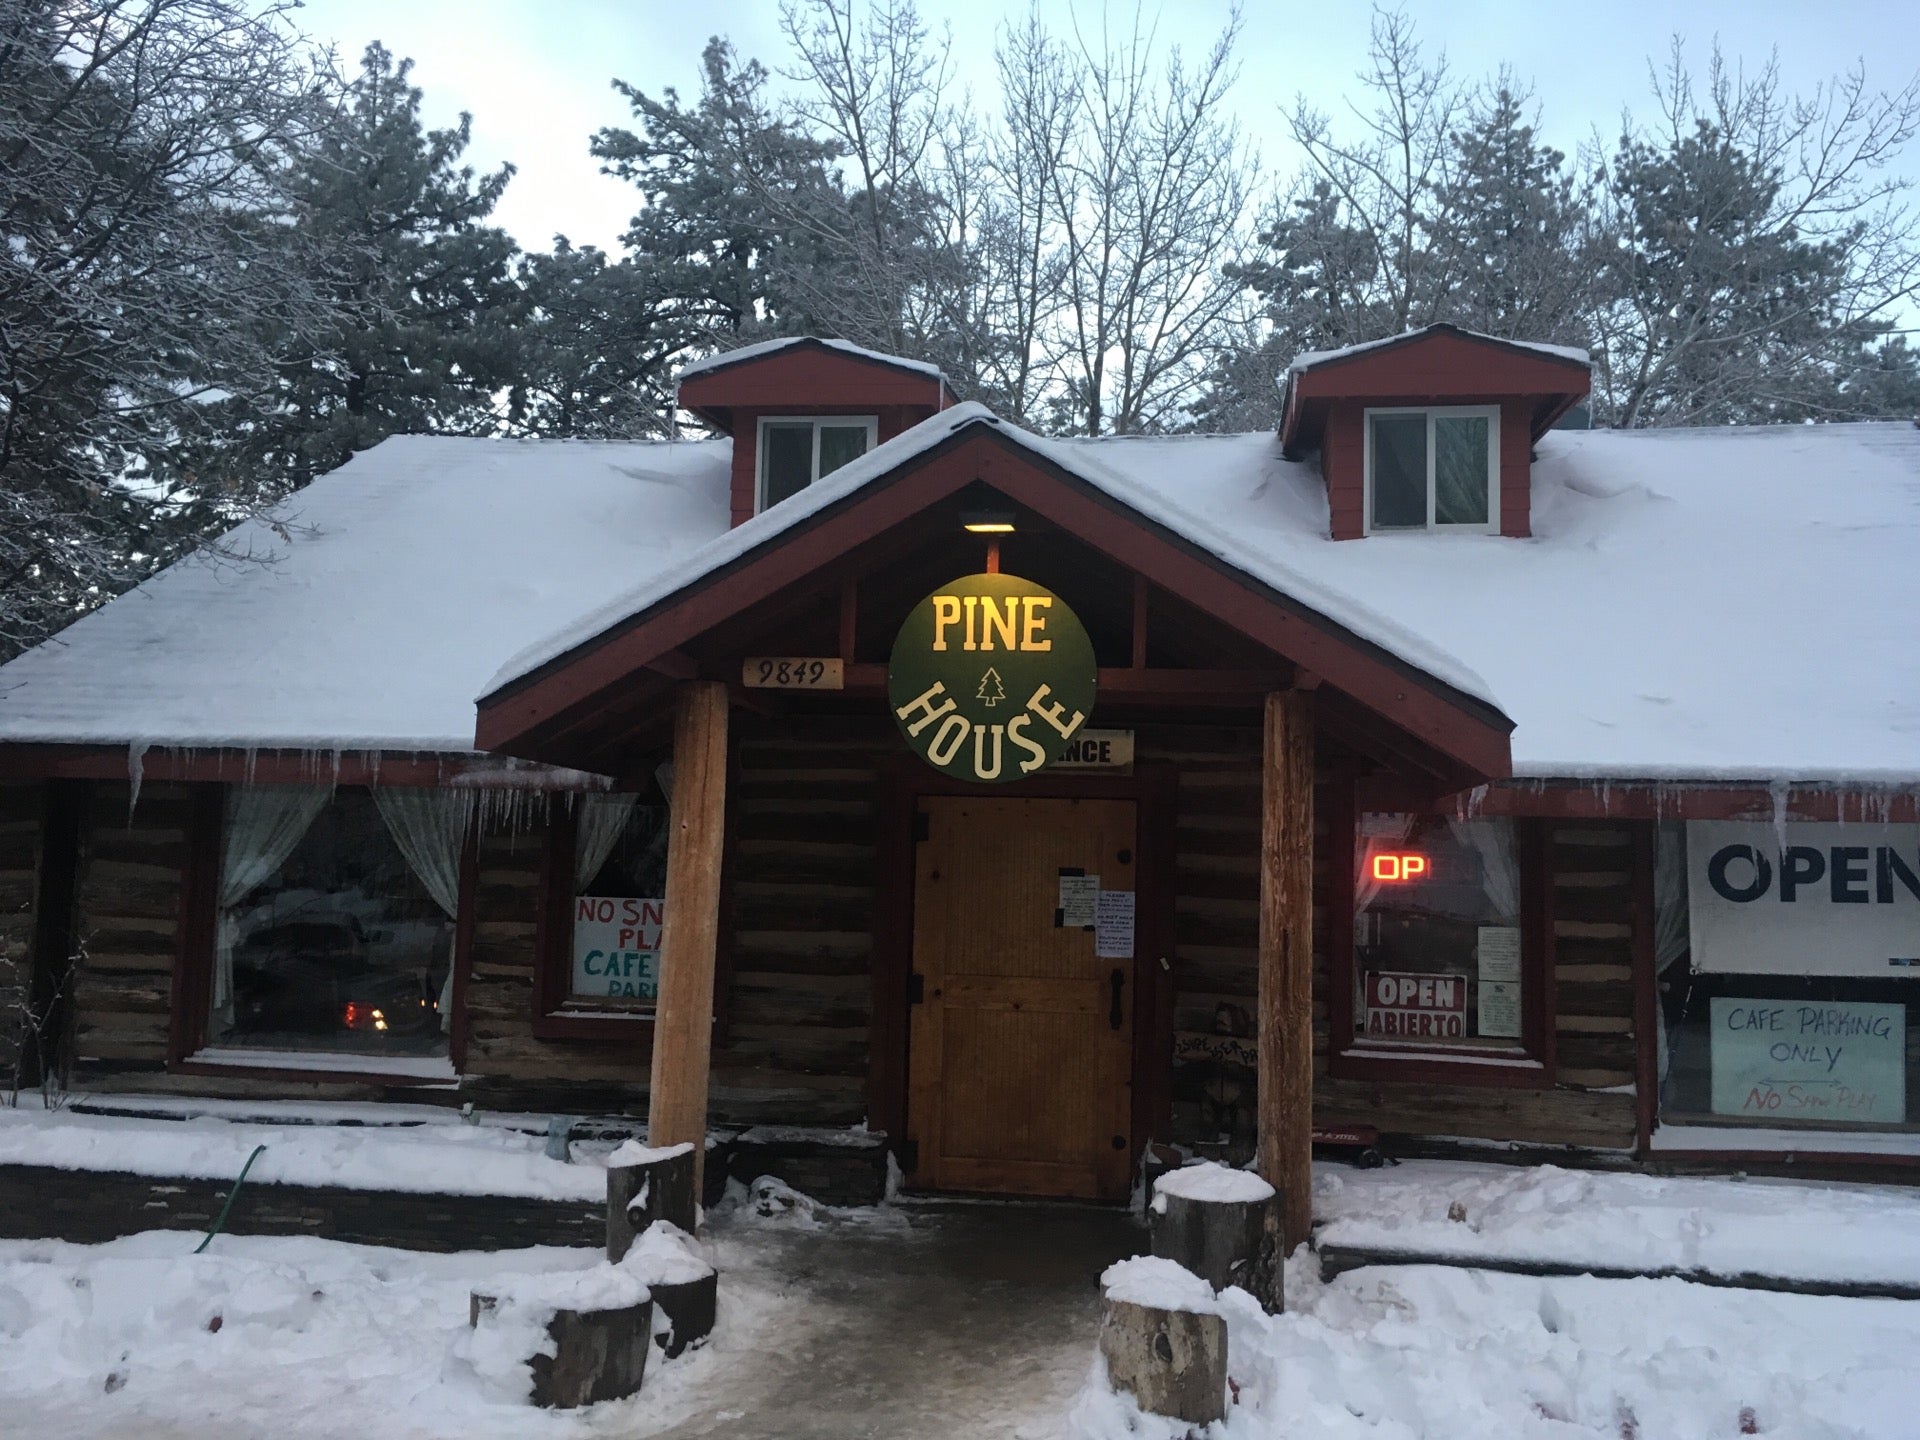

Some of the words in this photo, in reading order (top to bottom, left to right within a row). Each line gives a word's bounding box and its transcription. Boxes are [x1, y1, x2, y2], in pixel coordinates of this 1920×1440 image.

[932, 595, 1052, 651] PINE
[758, 660, 825, 685] 9849
[896, 681, 1085, 780] HOUSE
[1708, 844, 1920, 903] OPEN
[578, 899, 615, 923] NO
[584, 950, 652, 978] CAFE
[1377, 977, 1454, 1008] OPEN
[1369, 1011, 1462, 1038] ABIERTO
[1728, 1008, 1785, 1032] CAFE
[1800, 1007, 1890, 1040] PARKING
[1770, 1043, 1842, 1073] ONLY
